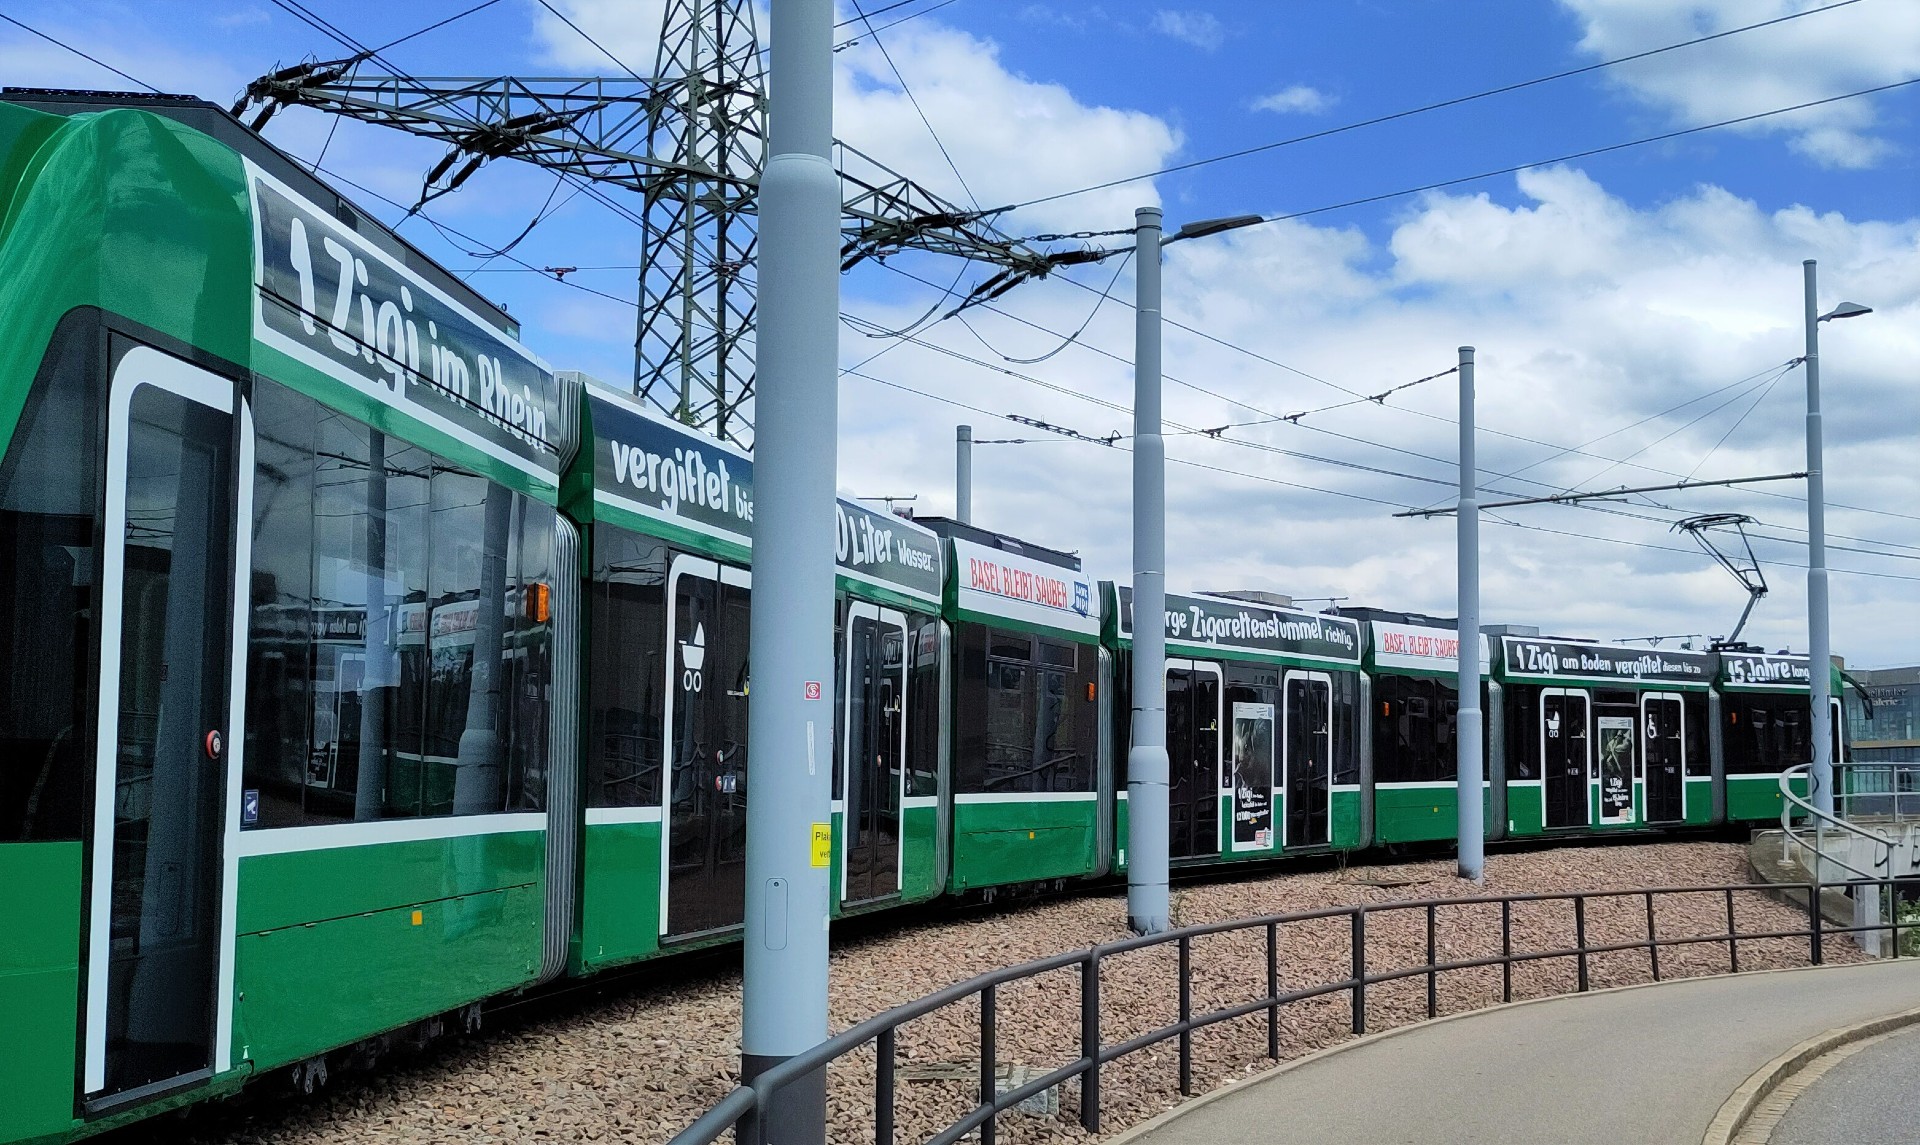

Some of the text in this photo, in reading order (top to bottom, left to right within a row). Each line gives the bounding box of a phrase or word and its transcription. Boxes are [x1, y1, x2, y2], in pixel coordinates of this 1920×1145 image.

[290, 217, 547, 454] 1 Zigi im Rhein
[611, 439, 731, 516] vergiftet
[848, 514, 893, 566] Liter
[896, 538, 935, 574] Wasser.
[969, 557, 1069, 609] BASEL BLEIBT SAUBER
[1188, 605, 1323, 645] Zigarettenstummel
[1324, 625, 1354, 651] richtig.
[1383, 632, 1408, 654] BASEL
[1408, 635, 1433, 656] BLEIBT
[1516, 643, 1525, 671] 1
[1525, 644, 1558, 676] Zigi
[1562, 656, 1579, 670] am
[1580, 653, 1611, 672] Boden
[1615, 654, 1662, 681] vergiftet
[1727, 658, 1745, 684] 15
[1746, 655, 1791, 683] Jahre
